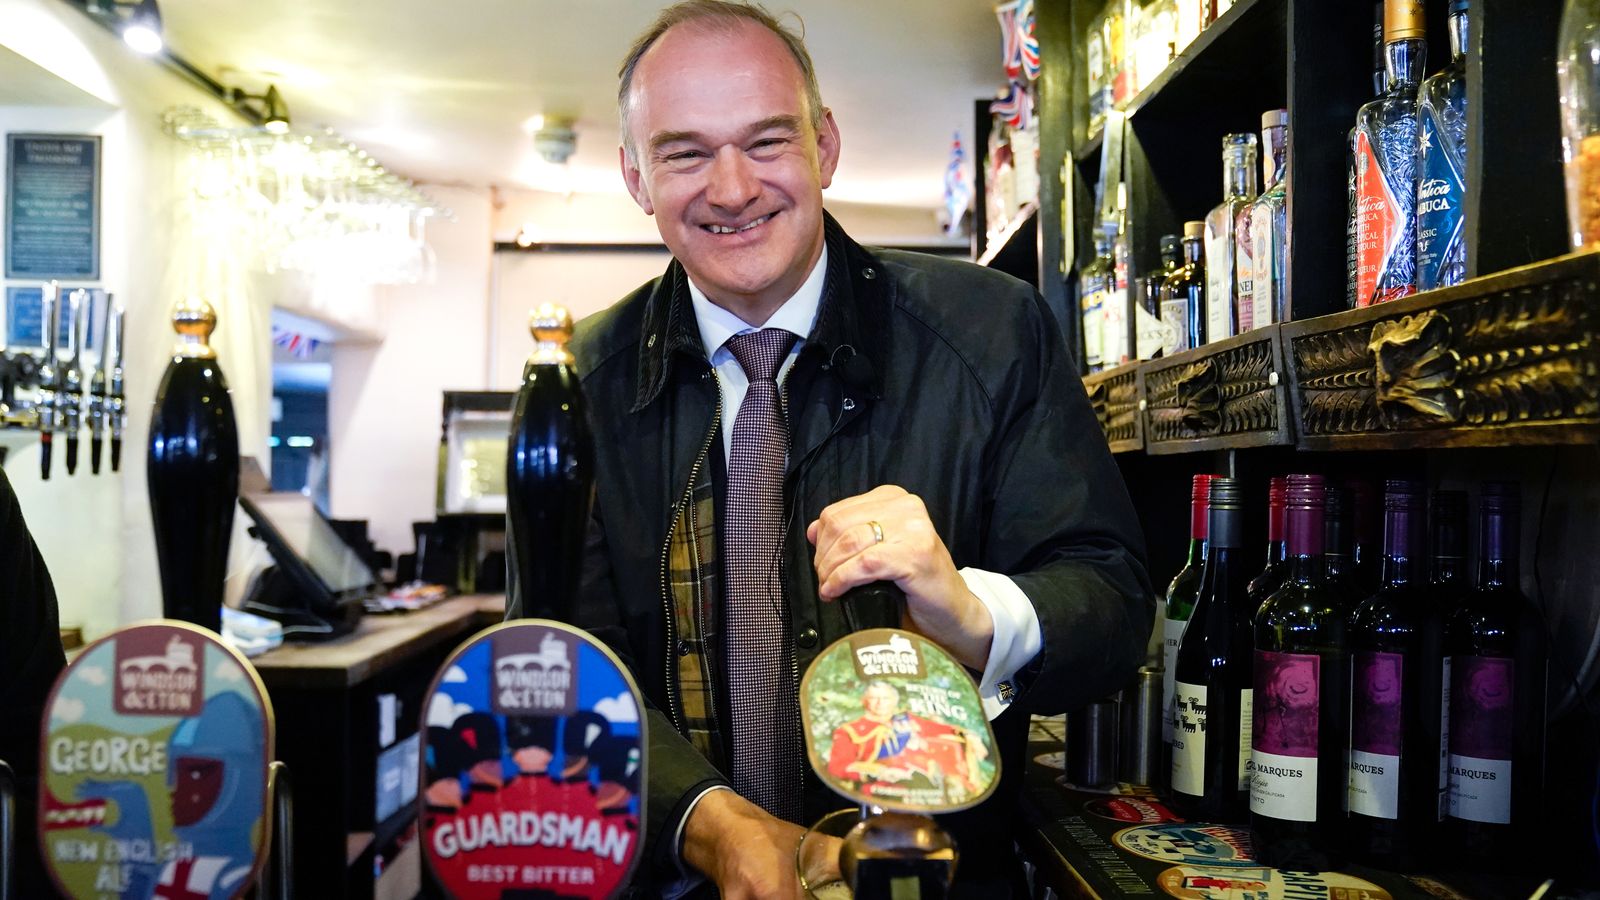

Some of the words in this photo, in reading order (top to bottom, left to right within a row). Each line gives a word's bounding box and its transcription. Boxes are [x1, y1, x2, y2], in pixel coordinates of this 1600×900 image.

[858, 652, 919, 666] WINDSOR
[120, 671, 197, 692] WINDSOR
[496, 669, 571, 689] WINDSOR
[908, 697, 968, 720] KING
[50, 736, 167, 775] GEORGE
[1257, 763, 1303, 778] MARQUES
[433, 811, 631, 865] GUARDSMAN
[55, 838, 98, 862] NEW
[103, 838, 194, 863] ENGLISH
[95, 863, 131, 893] ALE
[467, 864, 518, 883] BEST
[521, 866, 595, 885] BITTER
